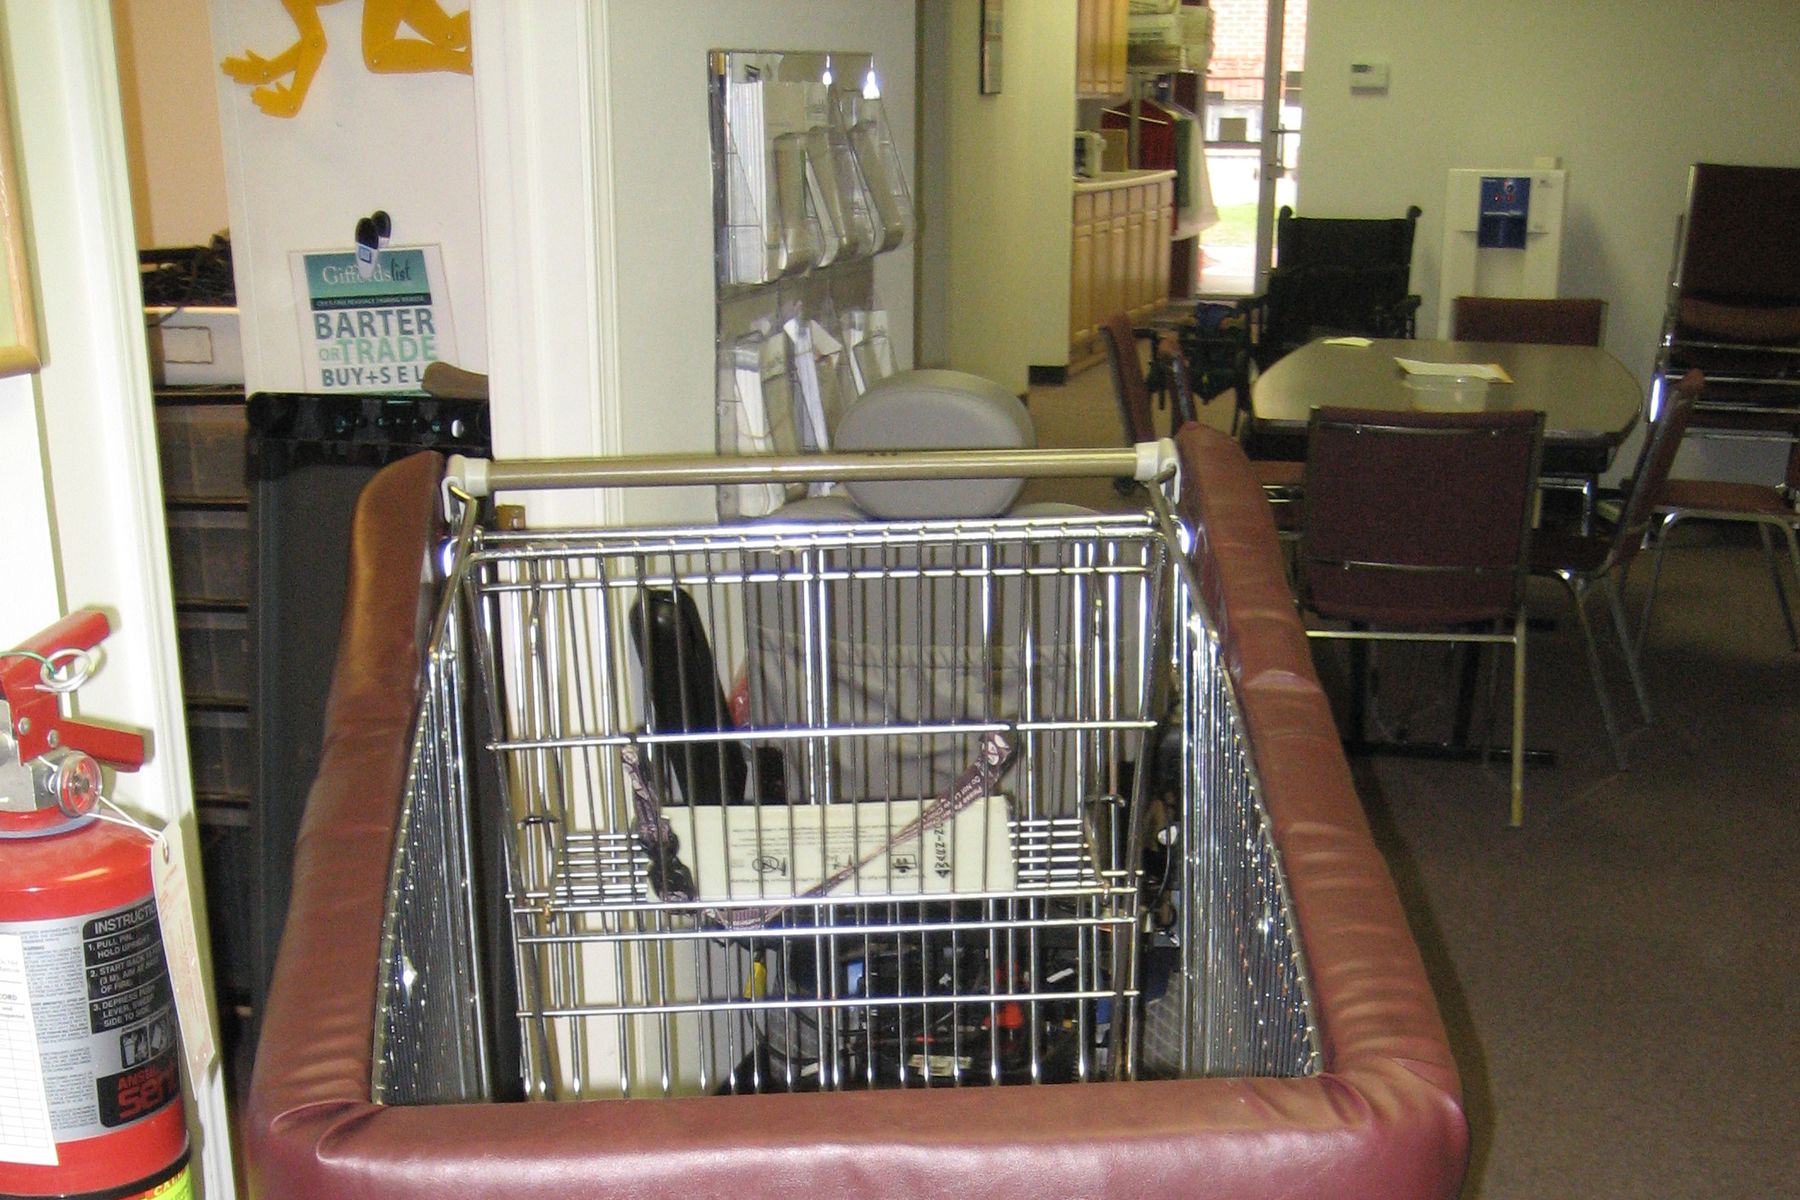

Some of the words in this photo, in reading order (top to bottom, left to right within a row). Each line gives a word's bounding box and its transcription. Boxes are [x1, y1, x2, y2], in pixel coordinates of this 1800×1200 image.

[322, 258, 411, 284] Giffdslist
[314, 308, 436, 340] BARTER
[318, 348, 341, 362] OR
[336, 335, 438, 365] TRADE
[321, 365, 424, 387] BUY+SEL
[97, 938, 118, 950] PULL
[97, 946, 120, 959] HOLD
[100, 962, 124, 975] START
[102, 992, 138, 1009] DEPRESS
[103, 1016, 122, 1027] SIDE
